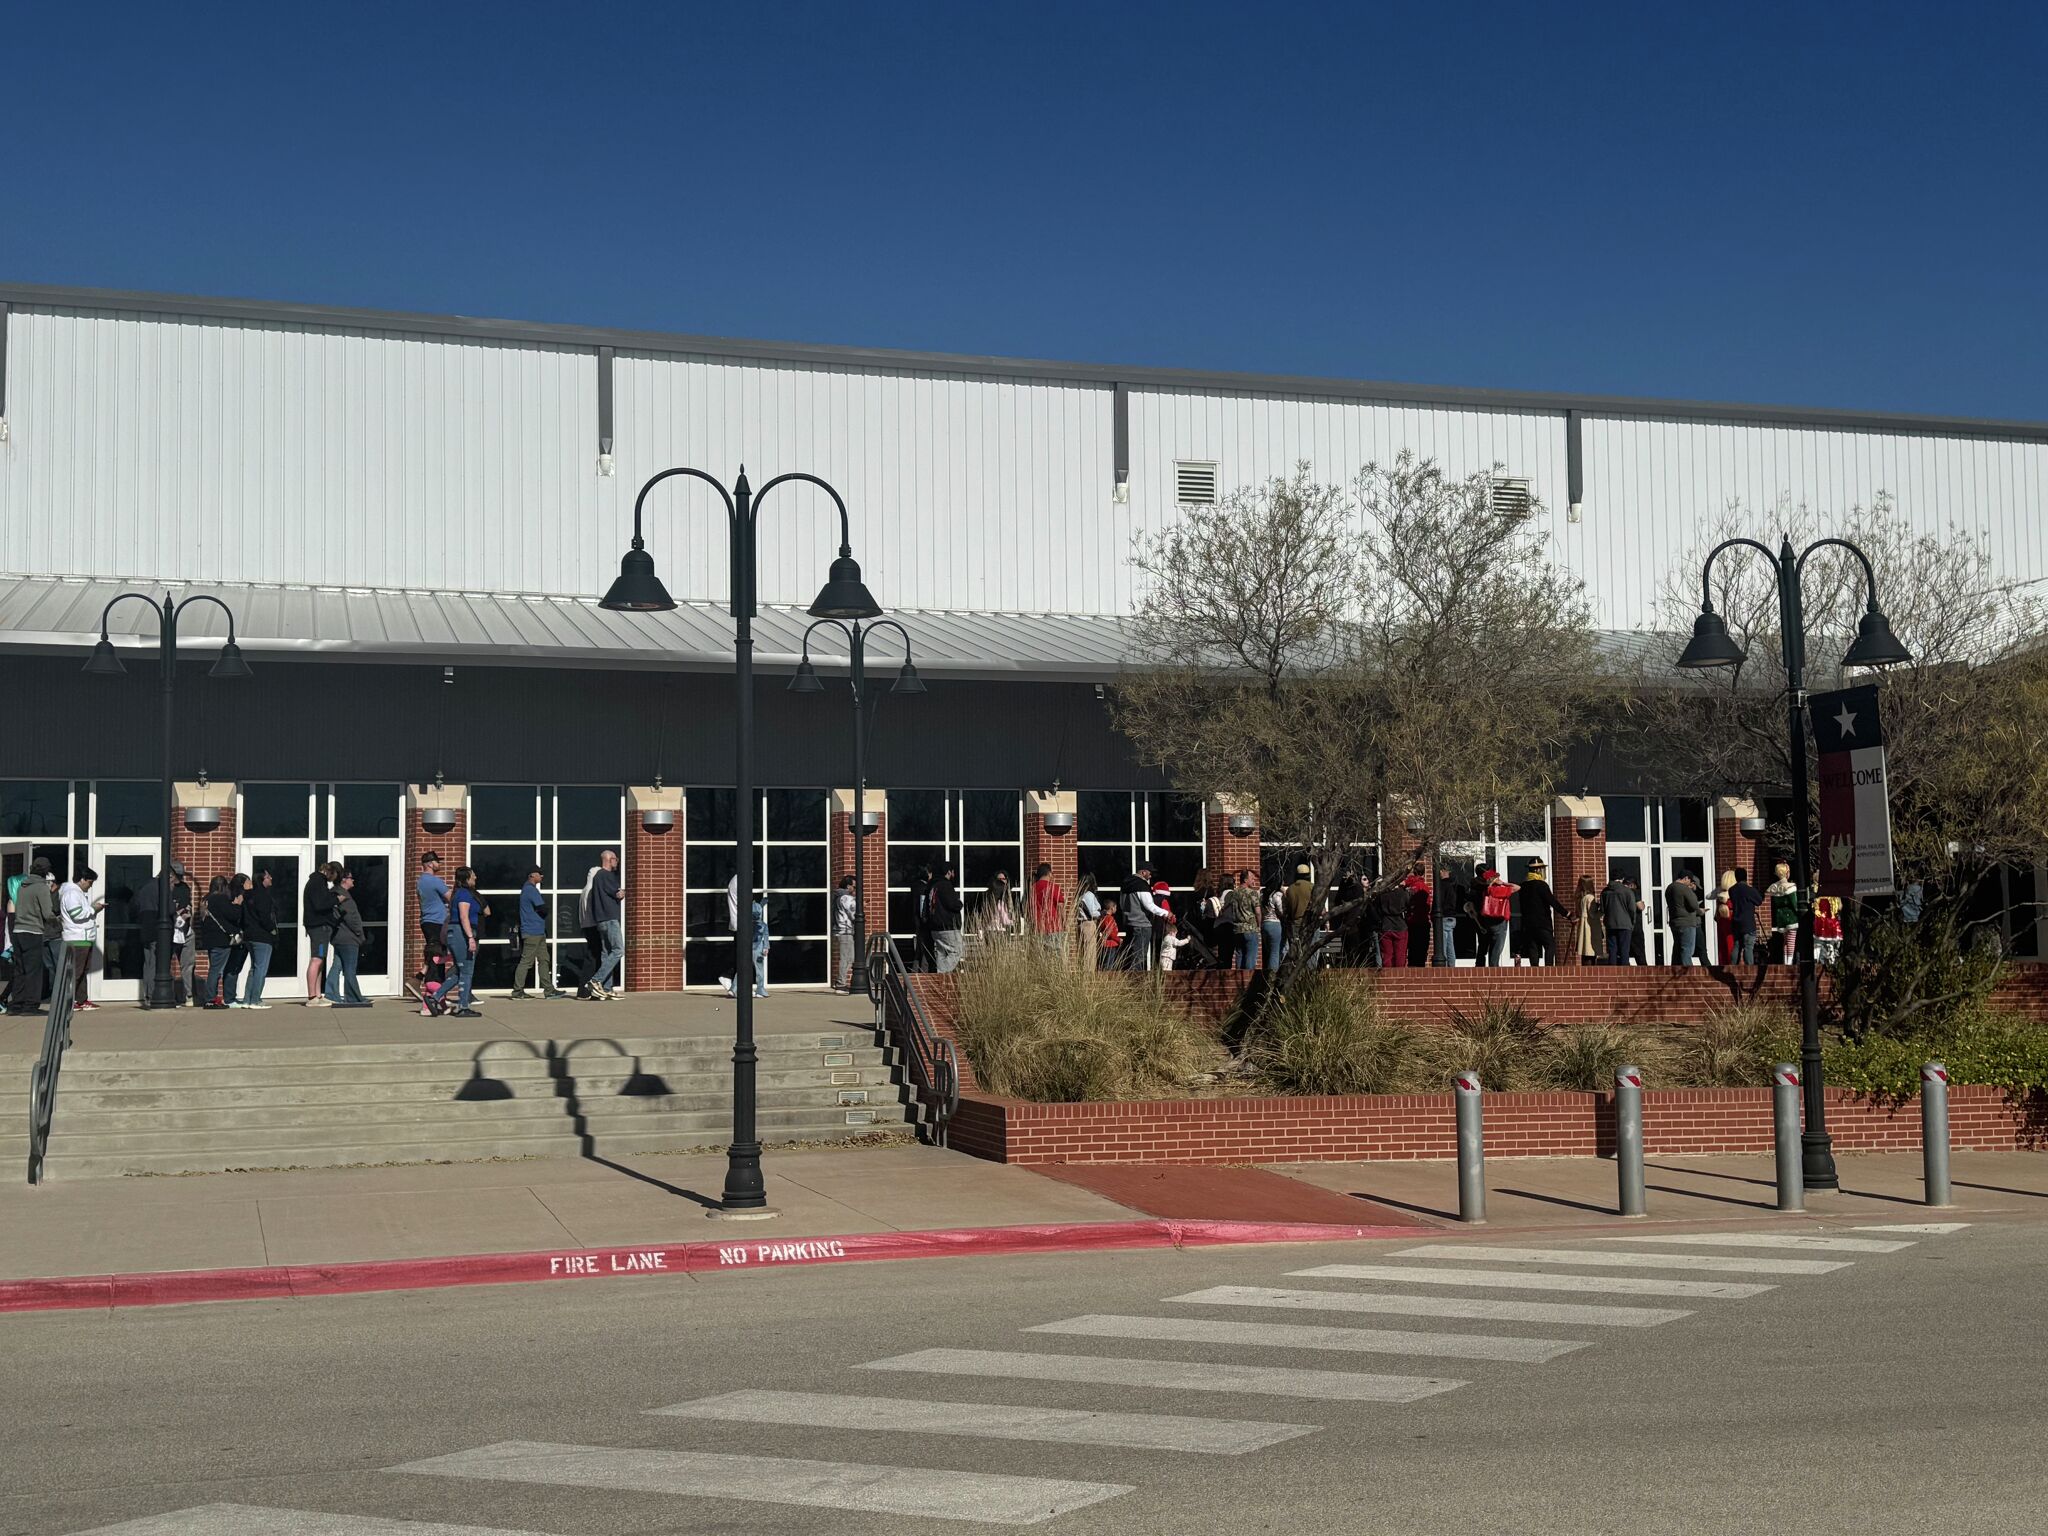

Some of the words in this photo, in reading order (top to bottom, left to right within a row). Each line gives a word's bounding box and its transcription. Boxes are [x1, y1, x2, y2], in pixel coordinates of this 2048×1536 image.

[1822, 767, 1883, 789] WELCOME
[550, 1255, 600, 1274] FIRE
[611, 1252, 668, 1271] LANE
[719, 1246, 747, 1265] NO
[757, 1240, 846, 1262] PARKING
